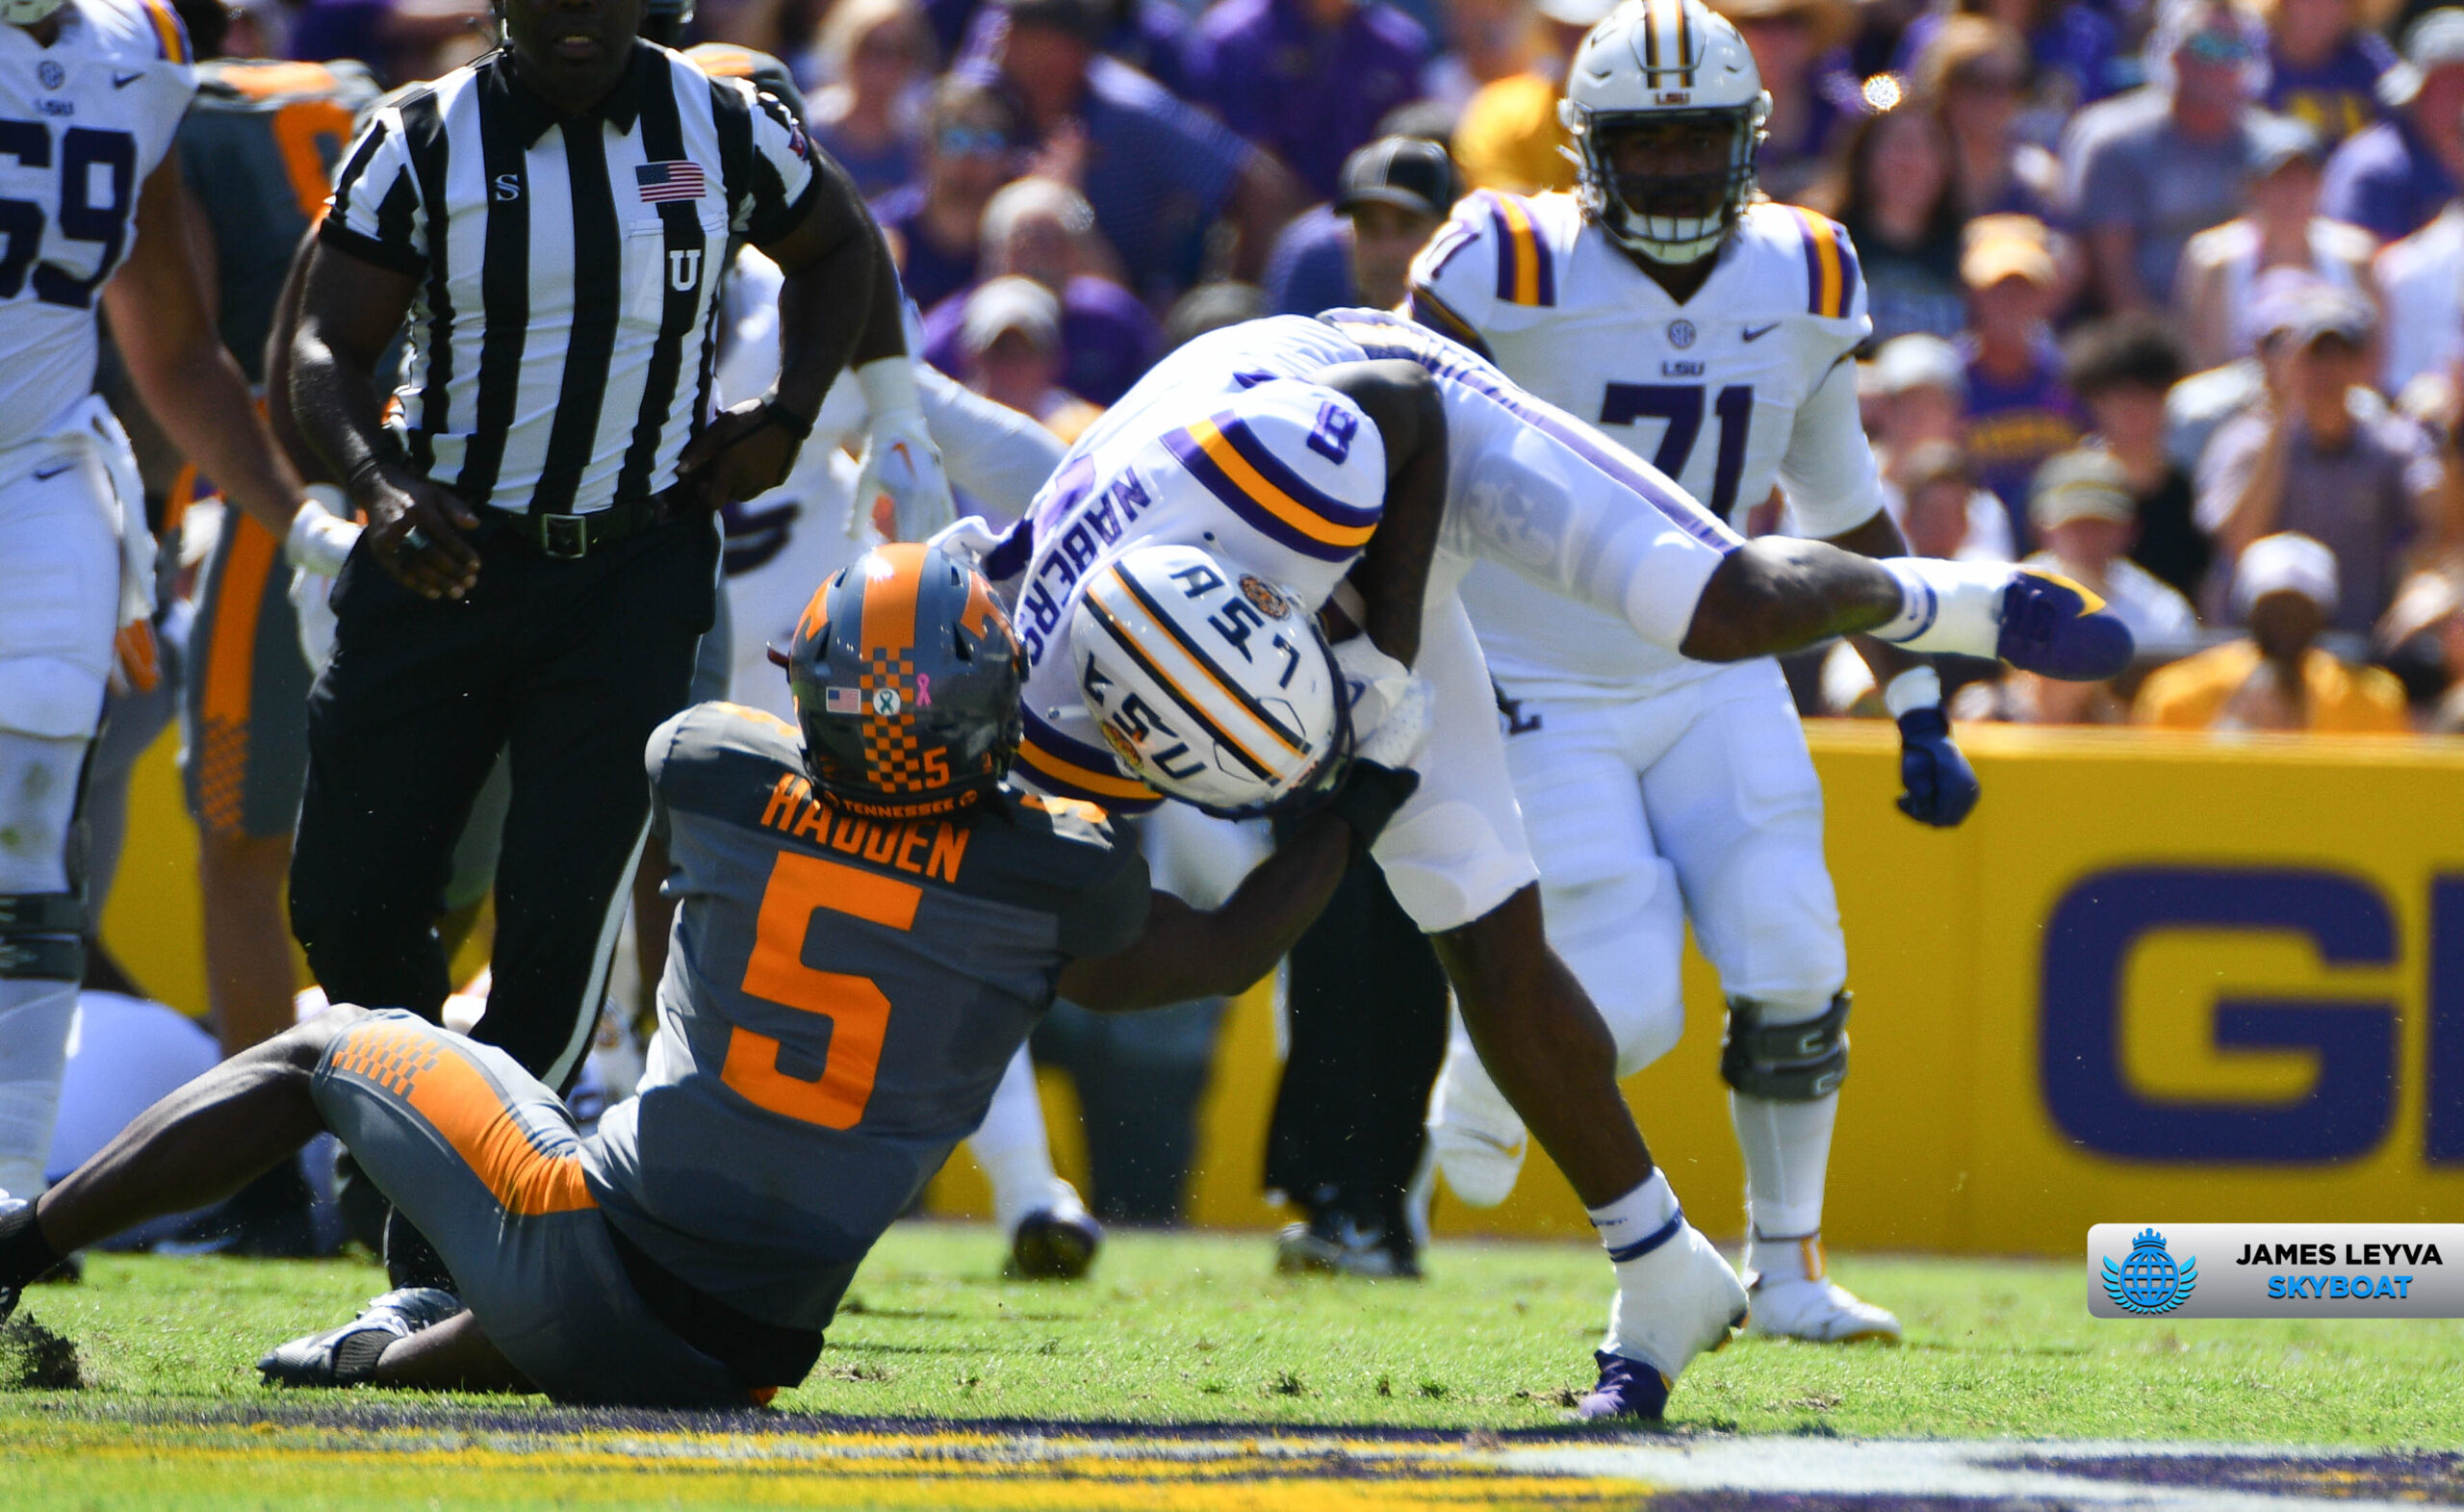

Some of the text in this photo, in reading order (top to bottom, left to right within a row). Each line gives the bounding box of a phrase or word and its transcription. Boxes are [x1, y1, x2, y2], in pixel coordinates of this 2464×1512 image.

[669, 249, 701, 292] U
[1662, 360, 1706, 377] LSU
[1306, 400, 1359, 466] 8
[1599, 380, 1755, 525] 71
[923, 746, 951, 789] 5
[759, 772, 970, 884] HADDEN
[842, 797, 955, 817] TENNESSEE
[720, 850, 923, 1131] 5
[2037, 861, 2464, 1172] G
